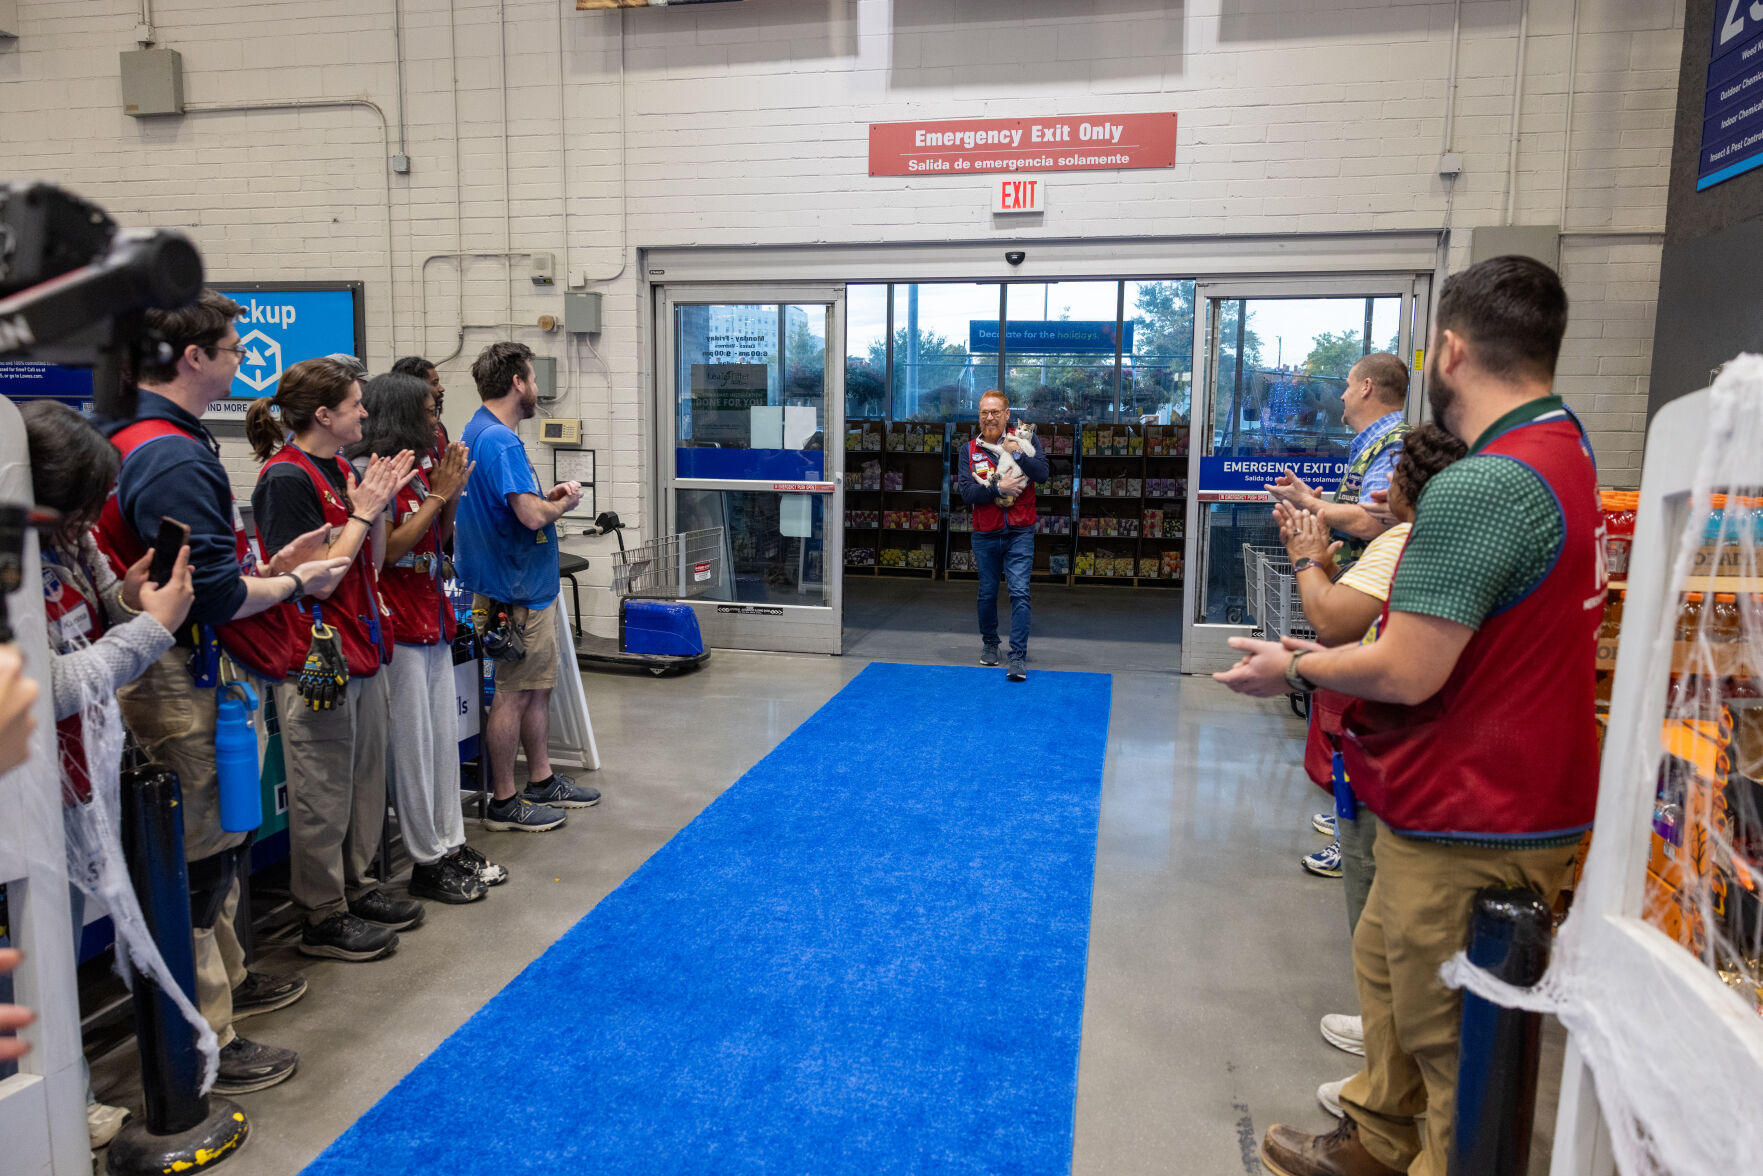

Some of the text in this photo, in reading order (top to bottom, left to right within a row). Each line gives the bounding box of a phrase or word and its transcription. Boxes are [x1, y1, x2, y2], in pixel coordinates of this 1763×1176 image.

[1742, 44, 1758, 60] Weed
[1720, 71, 1763, 101] Outdoor Chemica
[1720, 100, 1763, 130] Indoor Chemical
[915, 122, 1124, 149] Emergency Exit Only
[1709, 146, 1726, 163] Insect
[1726, 144, 1731, 154] &
[1731, 138, 1743, 152] Pest
[908, 153, 1130, 171] Salida de emergencia solamente
[1001, 180, 1038, 209] EXIT
[234, 298, 296, 329] ckup
[979, 329, 1021, 338] Decoate
[1023, 329, 1038, 339] for
[1039, 330, 1055, 338] the
[207, 403, 248, 412] IND MORE
[744, 398, 763, 406] YOU
[1223, 461, 1300, 474] EMERGENCY
[1303, 462, 1332, 474] EXIT
